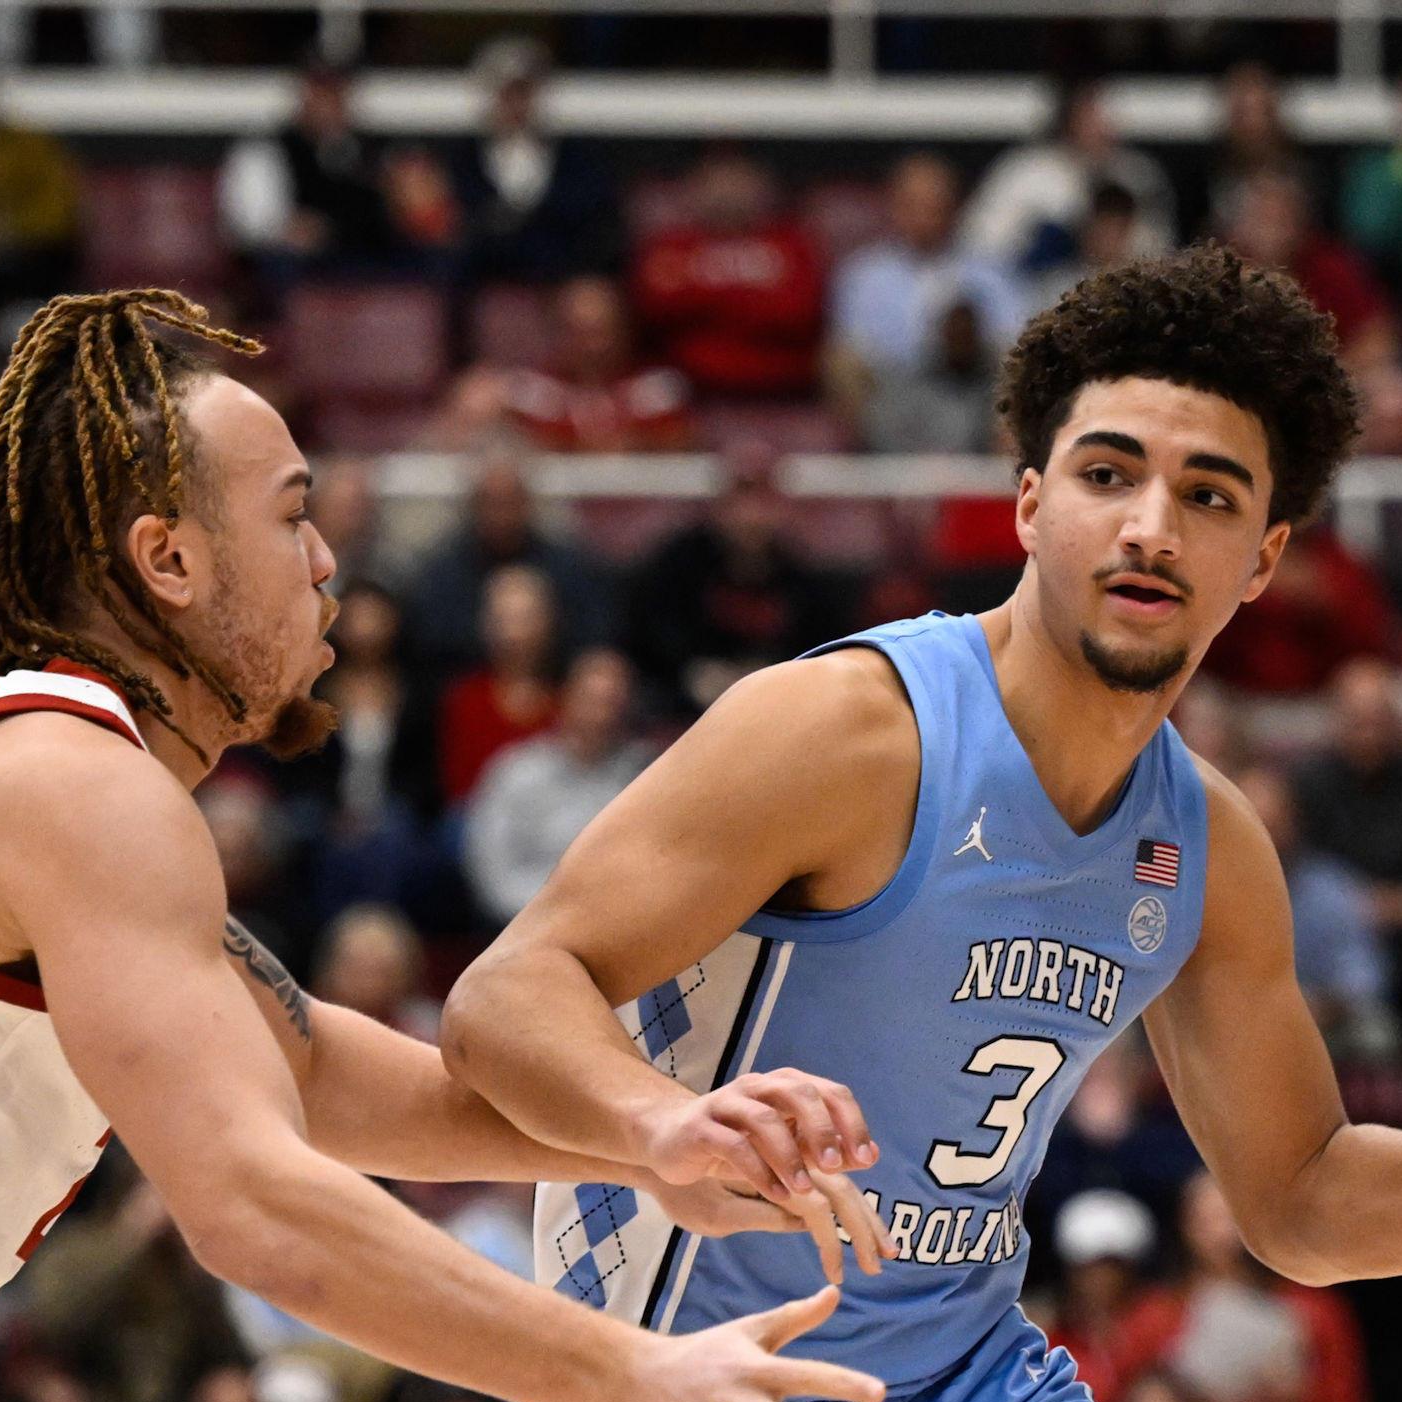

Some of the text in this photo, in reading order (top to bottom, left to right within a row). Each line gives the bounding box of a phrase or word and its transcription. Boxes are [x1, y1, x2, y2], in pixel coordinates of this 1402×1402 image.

[951, 937, 1125, 1026] NORTH
[924, 1034, 1067, 1190] 3
[832, 1188, 1023, 1265] ROLINA
